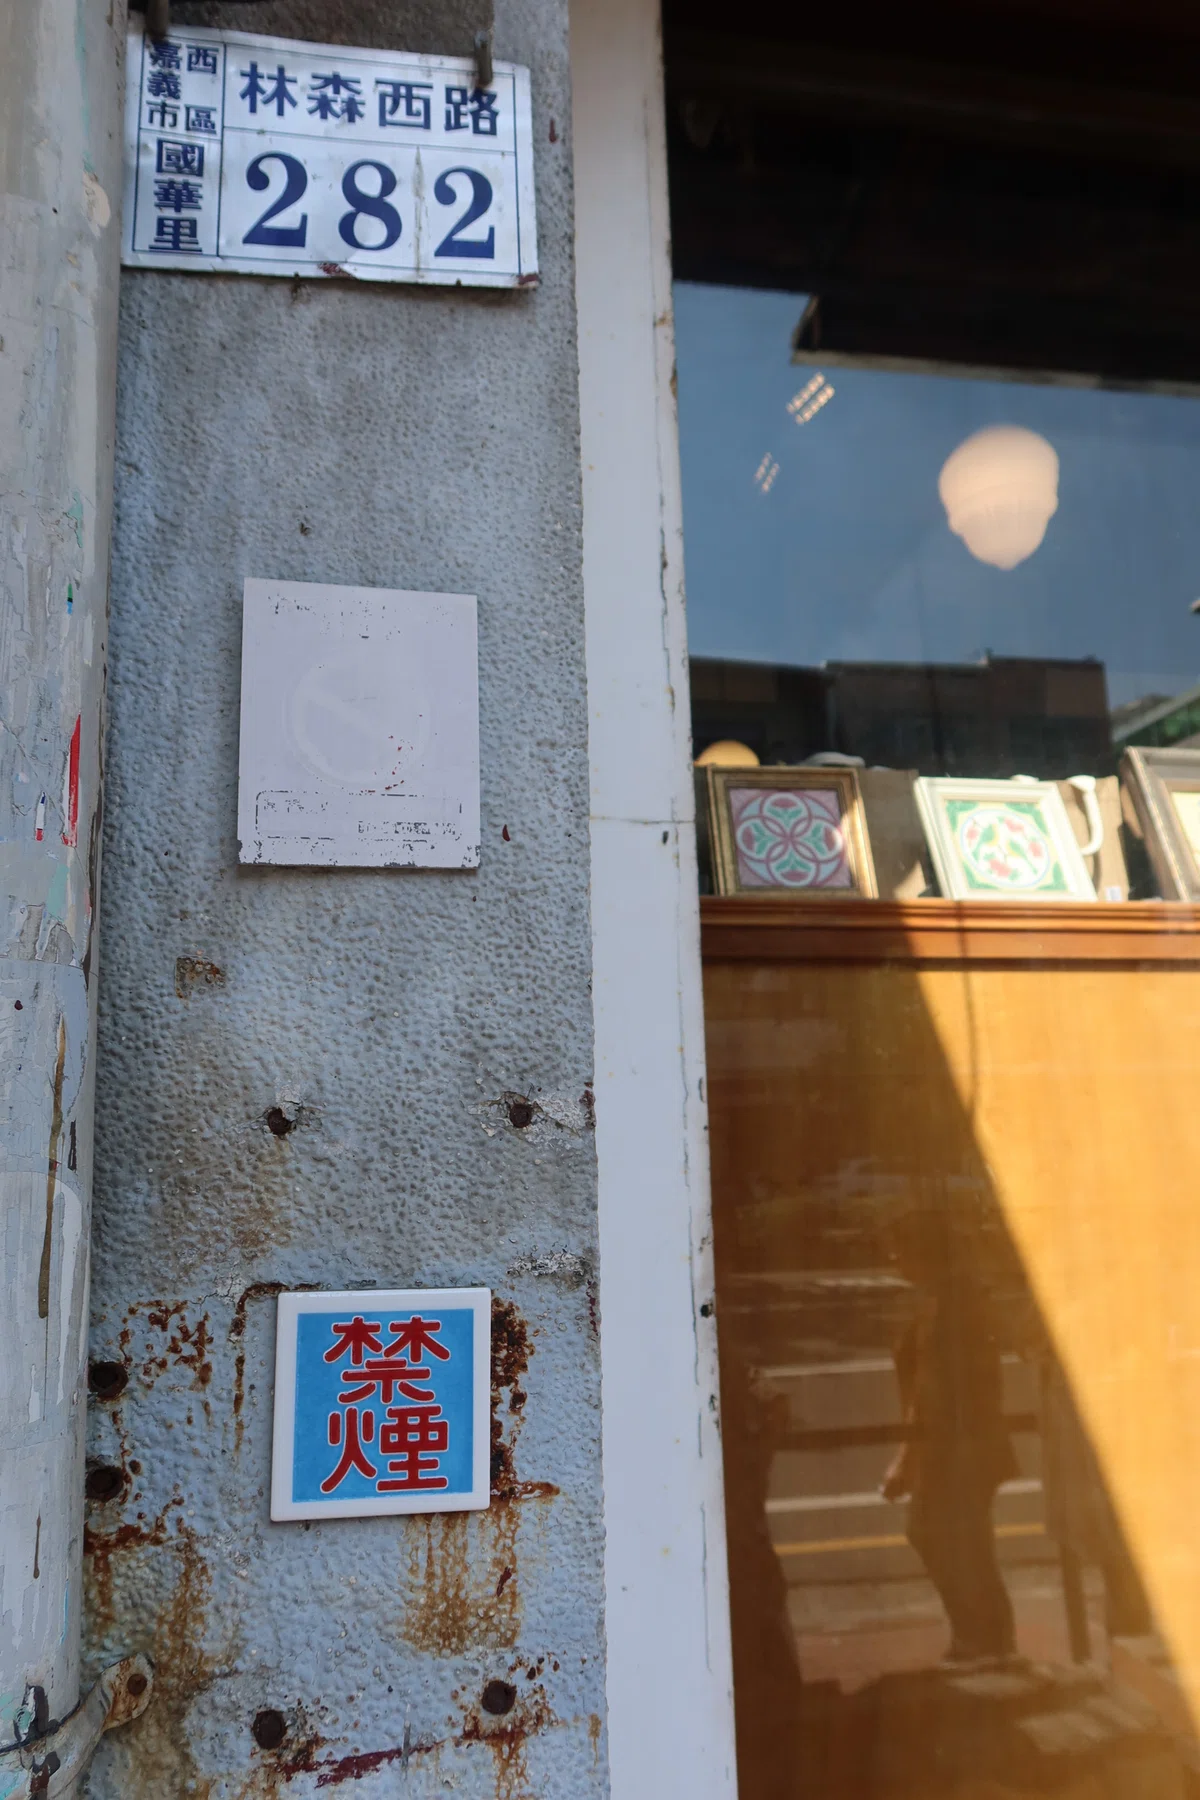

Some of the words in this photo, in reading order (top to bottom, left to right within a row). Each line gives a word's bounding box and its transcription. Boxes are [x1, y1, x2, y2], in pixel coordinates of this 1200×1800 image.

[239, 61, 500, 136] 林森西路
[149, 139, 205, 253] 國華里
[242, 151, 495, 260] 282
[320, 1315, 451, 1494] 禁煙
